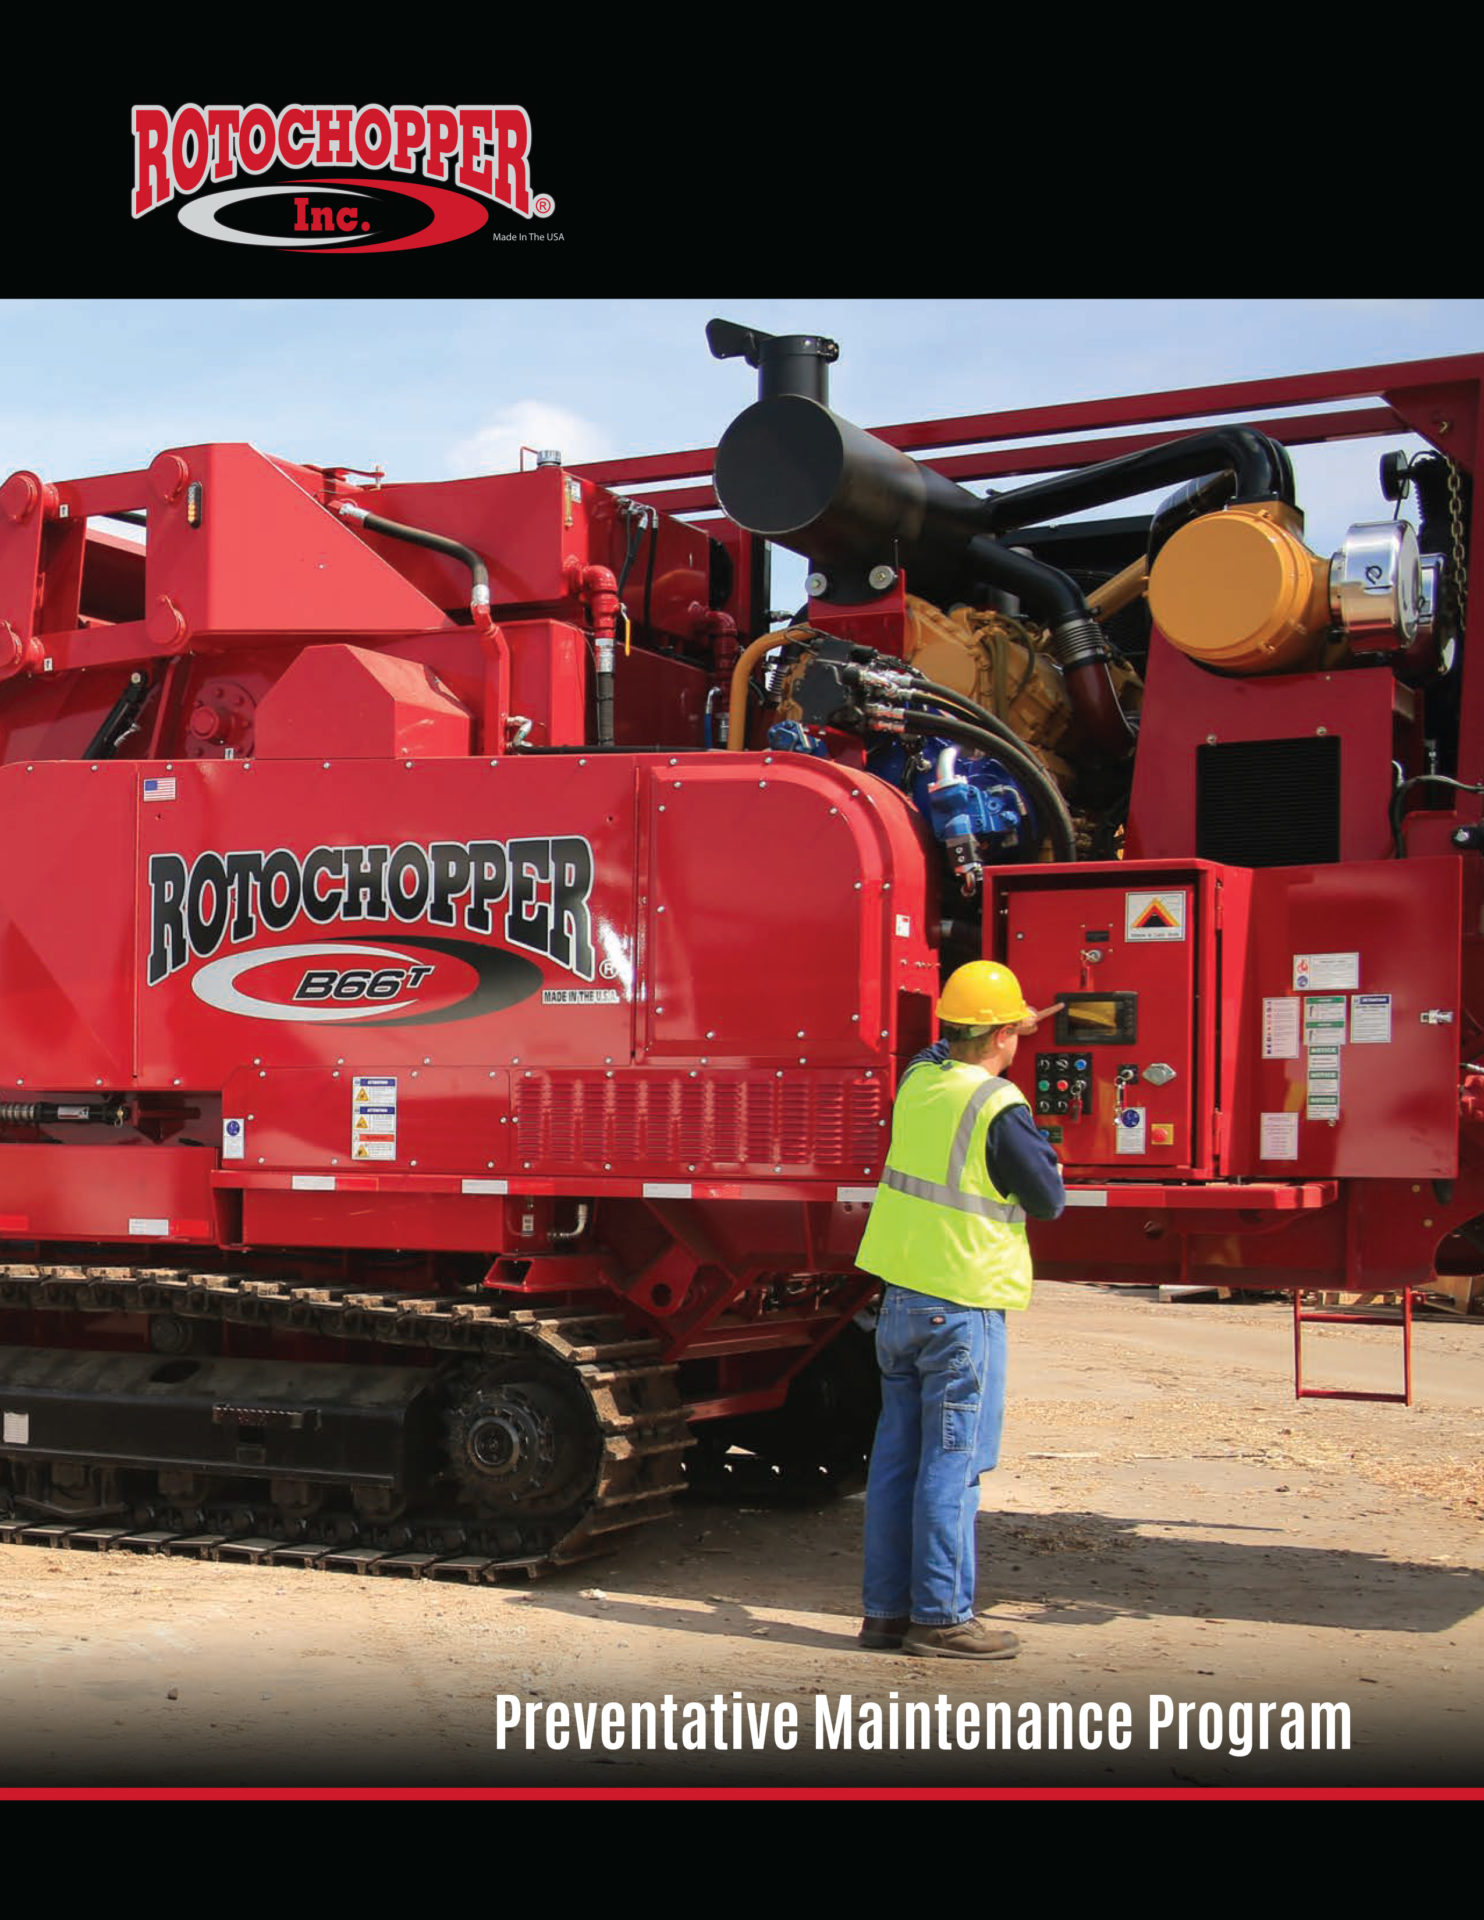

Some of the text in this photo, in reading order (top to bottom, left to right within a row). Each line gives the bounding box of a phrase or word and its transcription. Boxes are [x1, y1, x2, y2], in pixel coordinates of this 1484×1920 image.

[147, 835, 595, 986] ROTOCHOPPER
[544, 991, 567, 1002] MADE
[568, 991, 577, 1002] IN
[579, 991, 594, 1002] THE
